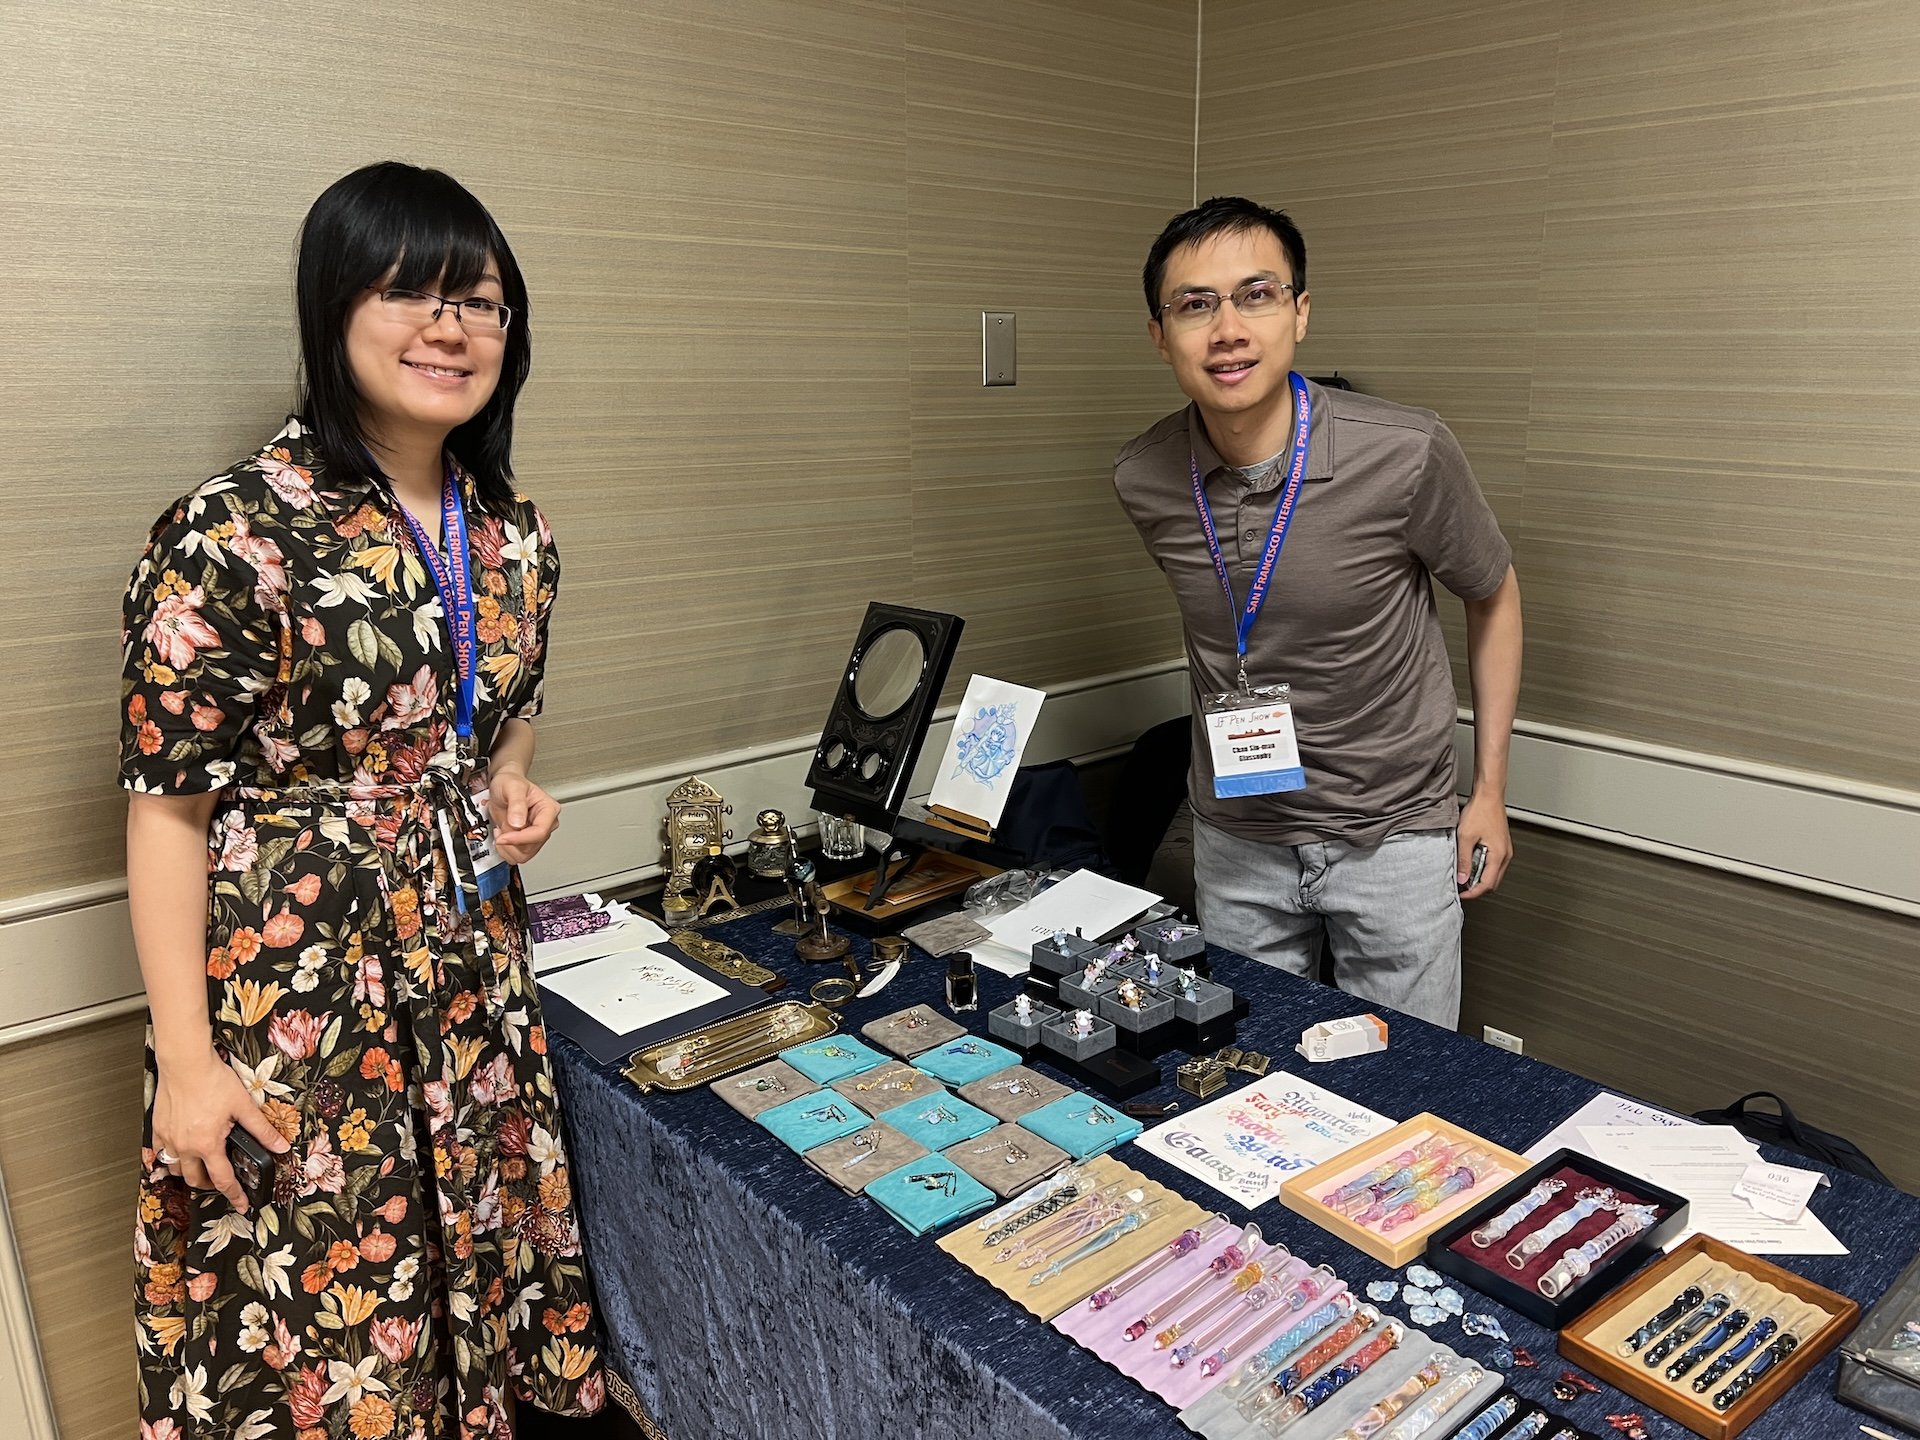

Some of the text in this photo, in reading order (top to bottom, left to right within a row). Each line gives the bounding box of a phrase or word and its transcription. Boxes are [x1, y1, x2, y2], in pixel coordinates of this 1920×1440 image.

[1247, 388, 1310, 613] SAN FRANCISCO INTERNATIONAL PEN SHOW
[445, 510, 467, 608] INTERNATIONAL
[458, 610, 471, 638] PEN
[458, 640, 472, 680] SHOW
